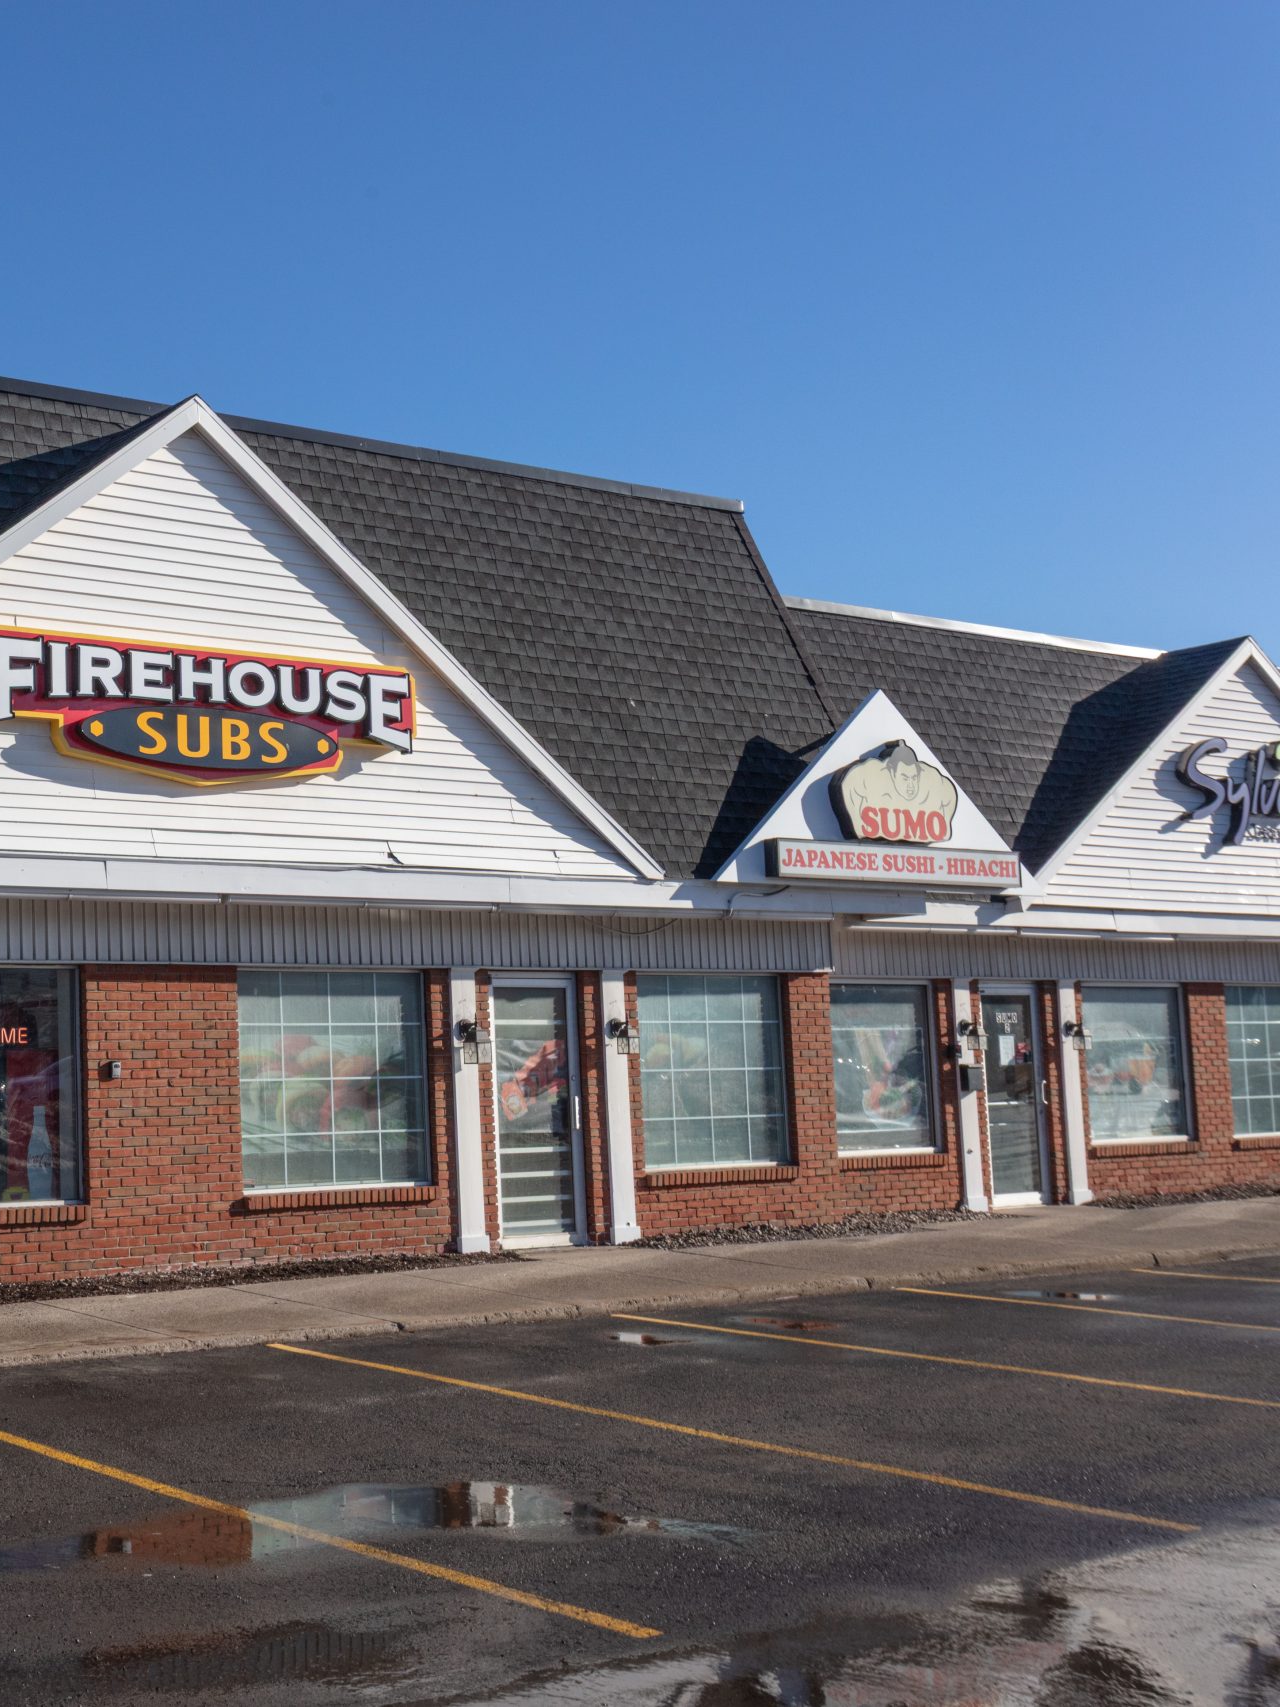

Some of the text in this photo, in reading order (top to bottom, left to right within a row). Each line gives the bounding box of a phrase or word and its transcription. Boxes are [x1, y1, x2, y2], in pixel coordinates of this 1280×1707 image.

[137, 711, 287, 764] SUBS
[1176, 737, 1280, 845] Sylv
[861, 807, 947, 843] SUMO
[781, 848, 879, 872] JAPANESE
[881, 854, 936, 874] SUSHI
[946, 858, 1017, 879] HIBACHI
